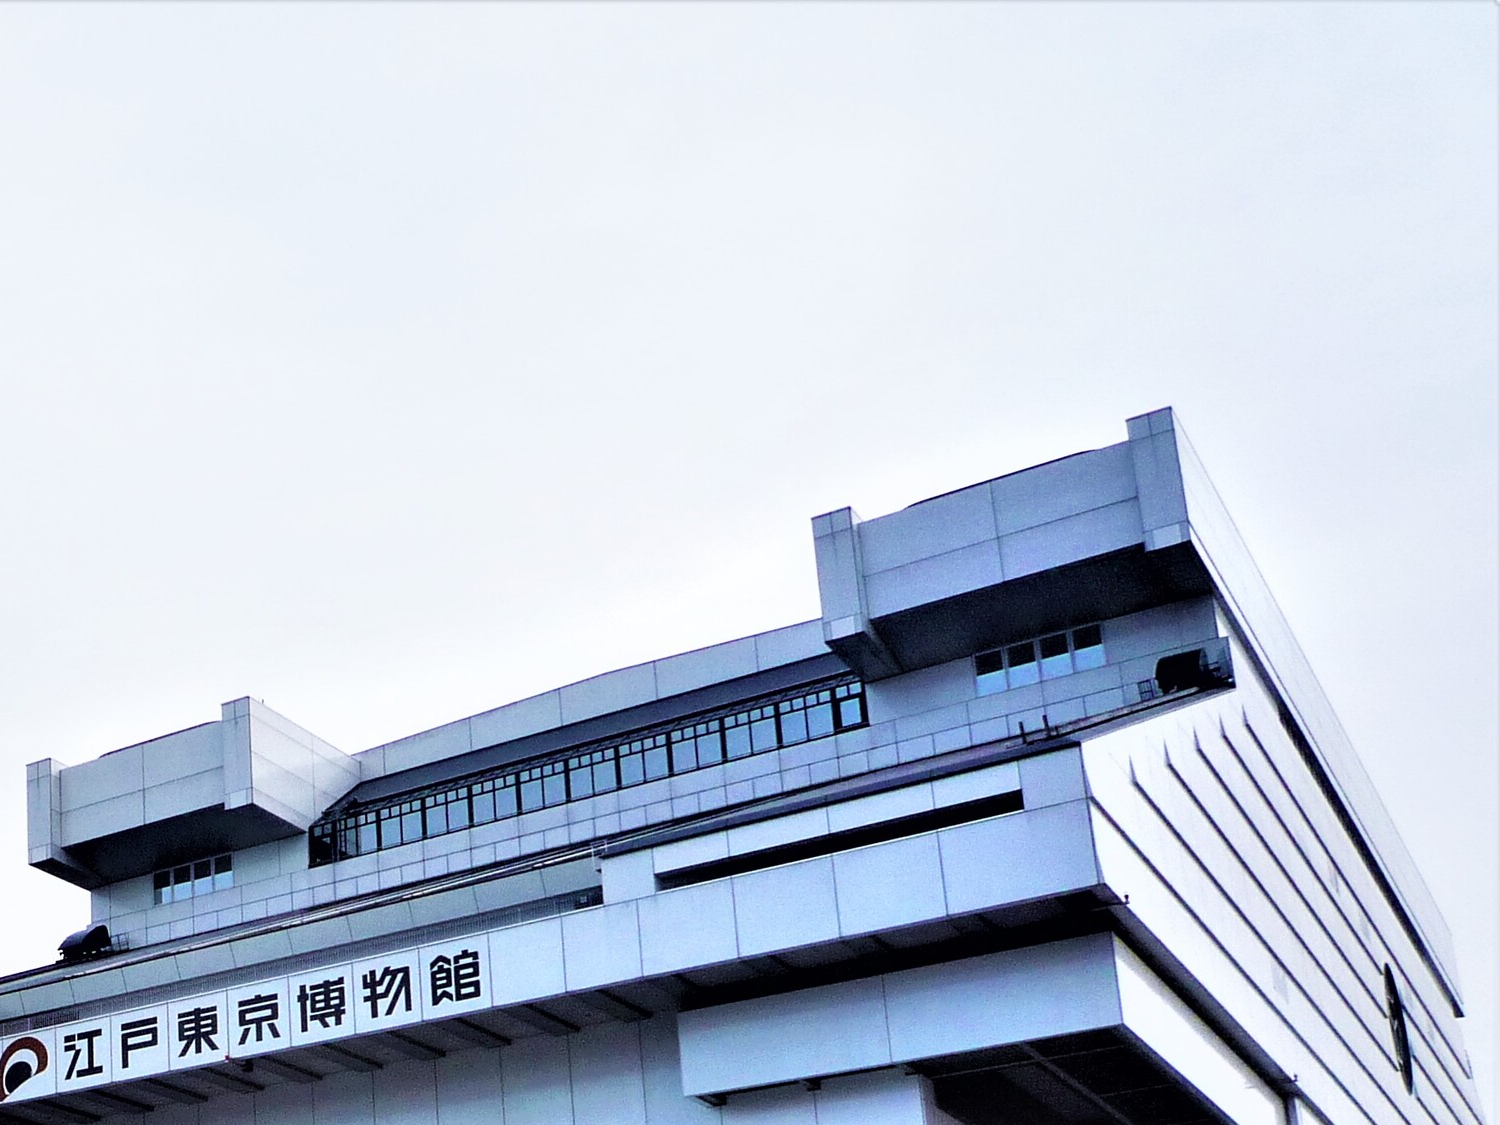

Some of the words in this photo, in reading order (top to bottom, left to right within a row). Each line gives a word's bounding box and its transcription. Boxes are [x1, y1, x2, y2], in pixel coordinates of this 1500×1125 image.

[63, 949, 482, 1081] 江戸東京博物館
